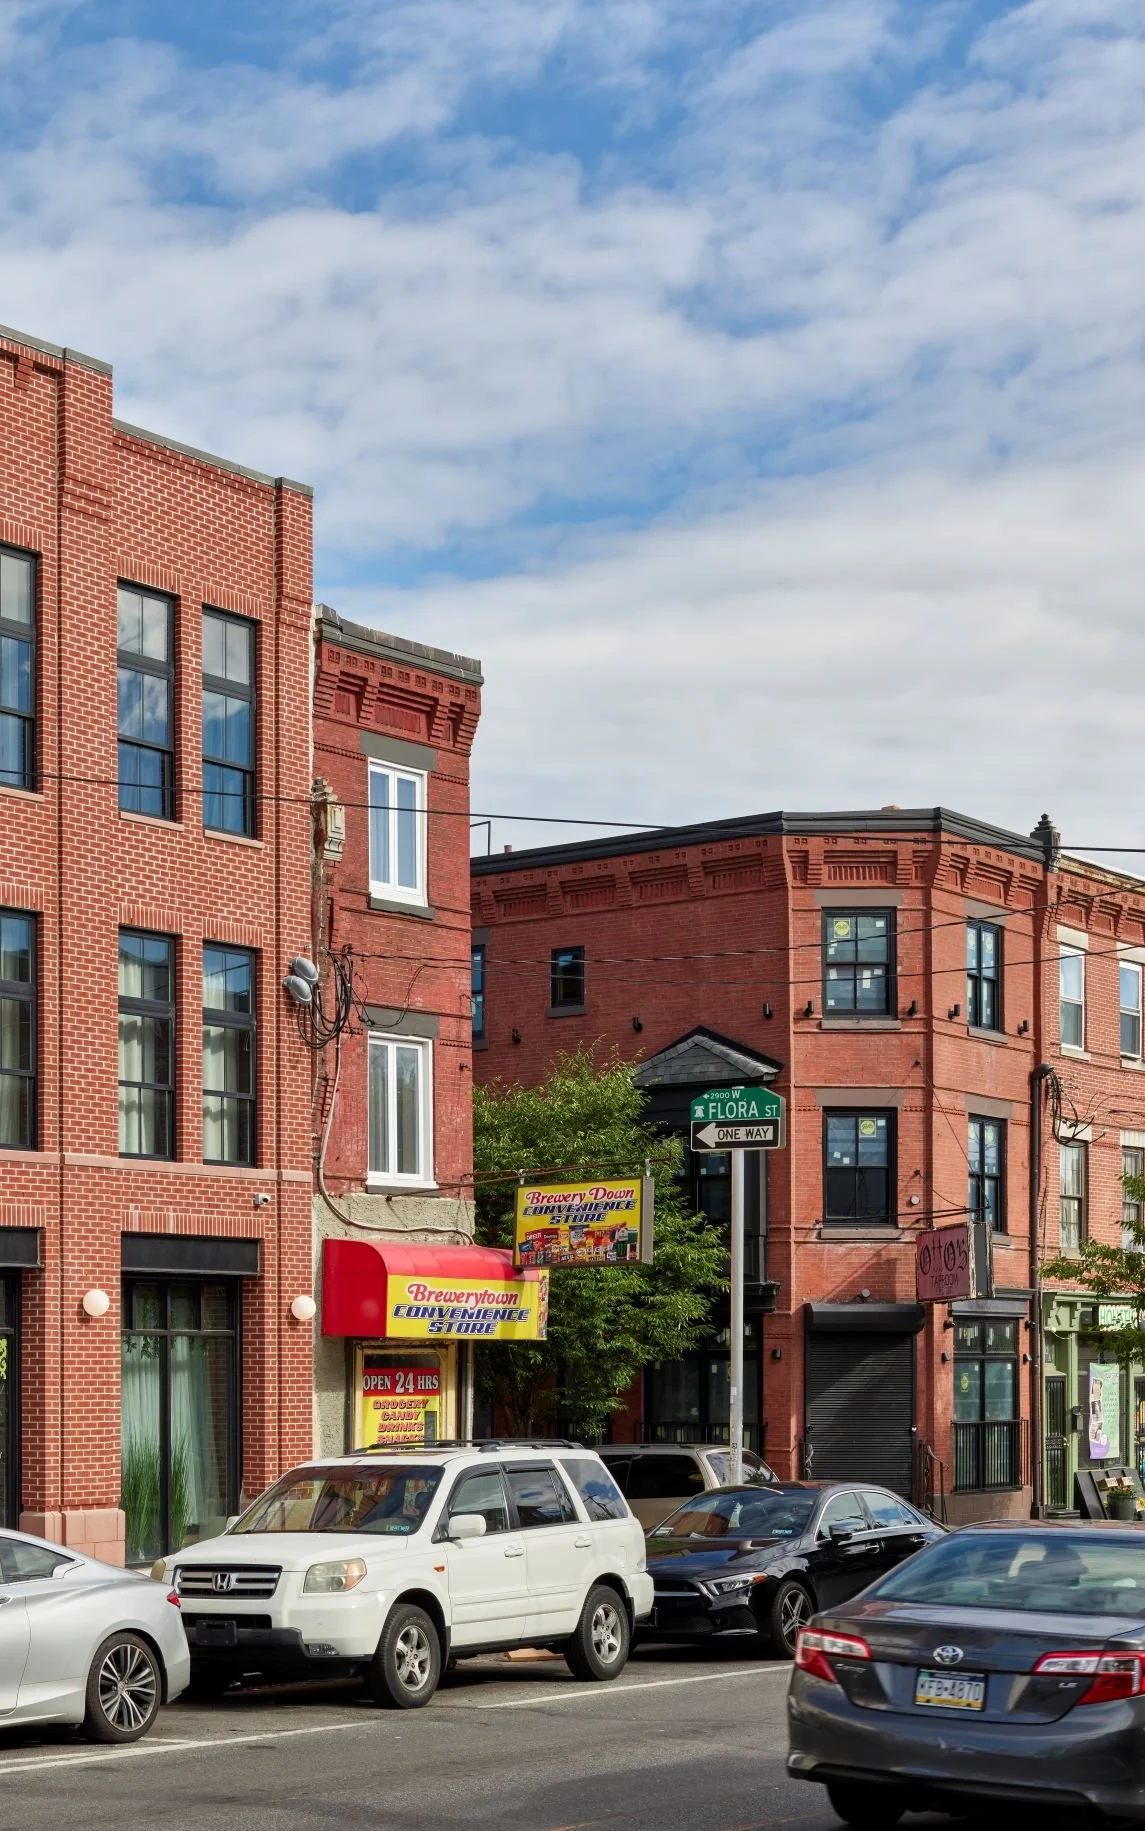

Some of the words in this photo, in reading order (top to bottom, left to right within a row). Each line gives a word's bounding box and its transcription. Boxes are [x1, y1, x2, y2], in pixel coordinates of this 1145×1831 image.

[731, 1090, 740, 1099] W
[709, 1101, 759, 1119] FLORA
[765, 1105, 777, 1116] ST
[717, 1128, 741, 1141] ONE
[745, 1127, 770, 1139] WAY
[526, 1191, 586, 1207] Brewery
[589, 1187, 635, 1201] Down
[523, 1200, 637, 1216] CONVENIENCE
[550, 1213, 609, 1225] STORE
[407, 1283, 519, 1310] Brewerytown
[393, 1304, 530, 1322] CONVENIENCE
[428, 1321, 497, 1335] STORE
[363, 1375, 392, 1390] OPEN
[395, 1371, 415, 1394] 24
[417, 1375, 439, 1390] HRS
[372, 1399, 429, 1409] GROCERY
[381, 1410, 421, 1421] CANDY
